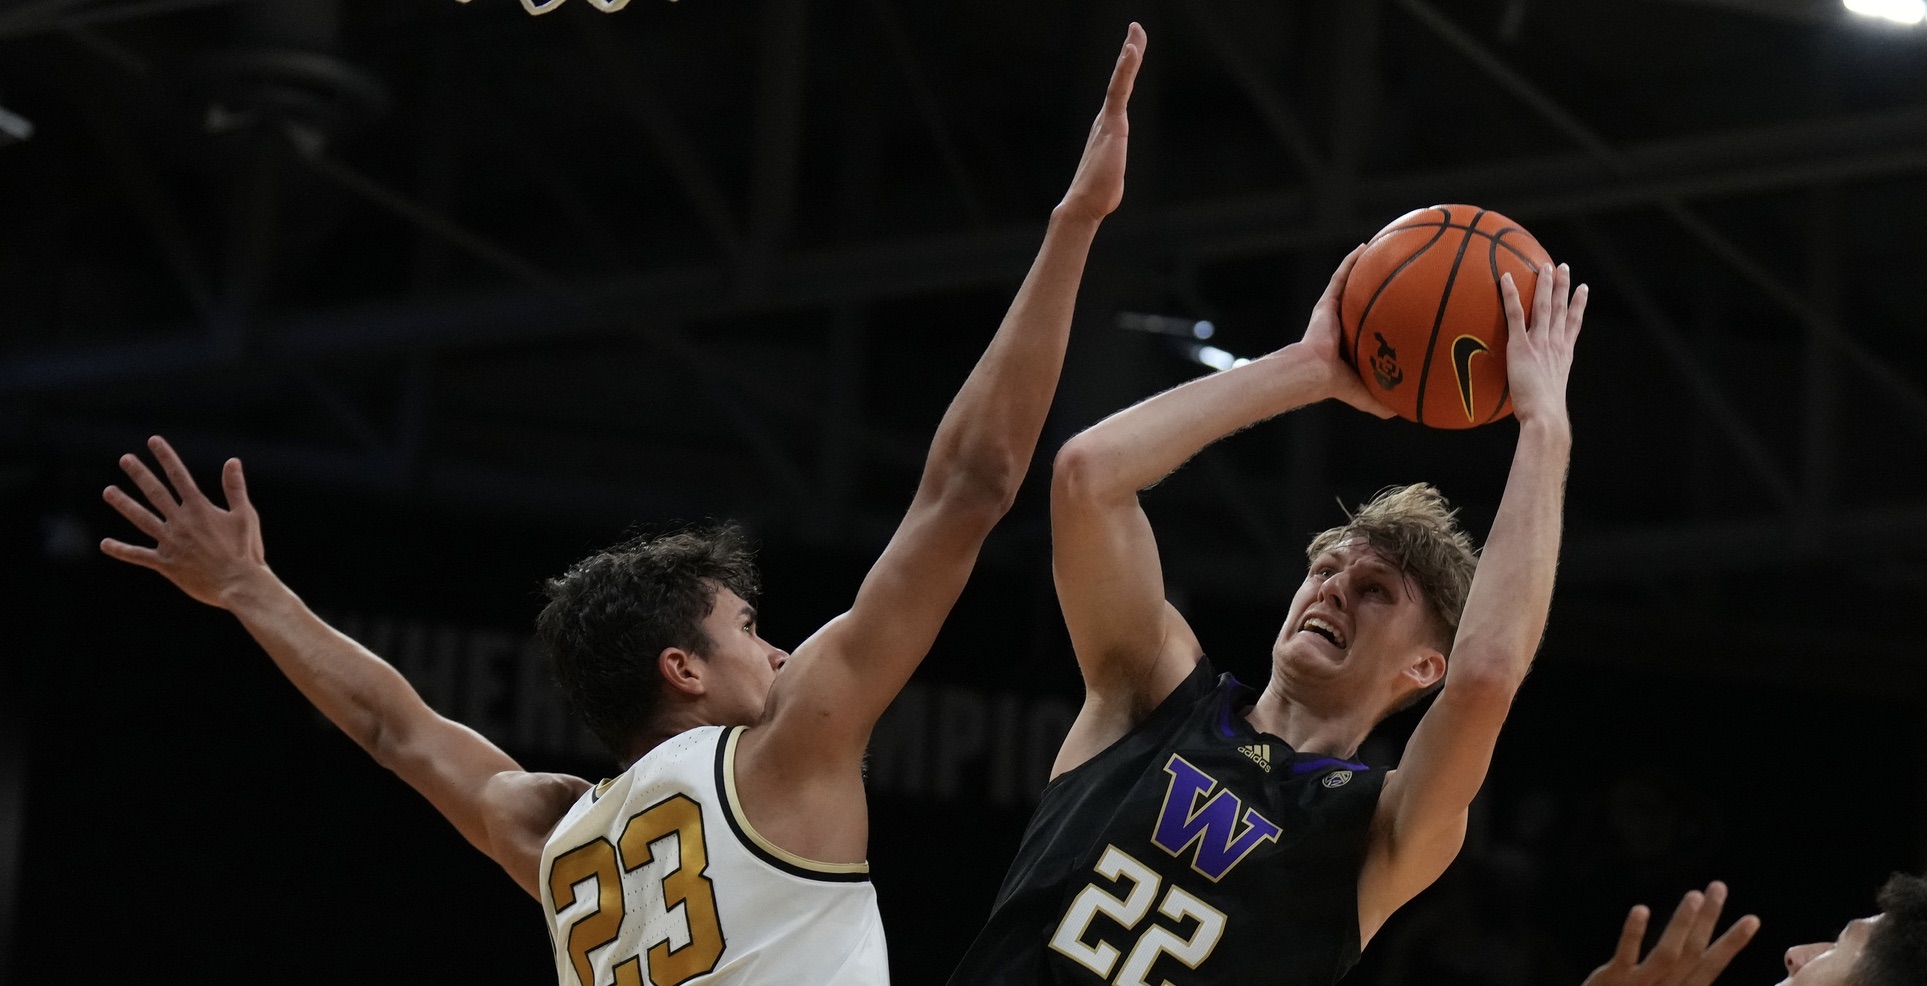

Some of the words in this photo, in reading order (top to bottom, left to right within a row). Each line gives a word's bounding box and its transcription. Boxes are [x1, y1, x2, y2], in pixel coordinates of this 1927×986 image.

[1150, 753, 1284, 883] W
[1237, 746, 1272, 773] adidas
[549, 793, 726, 986] 23
[1048, 843, 1228, 986] 22
